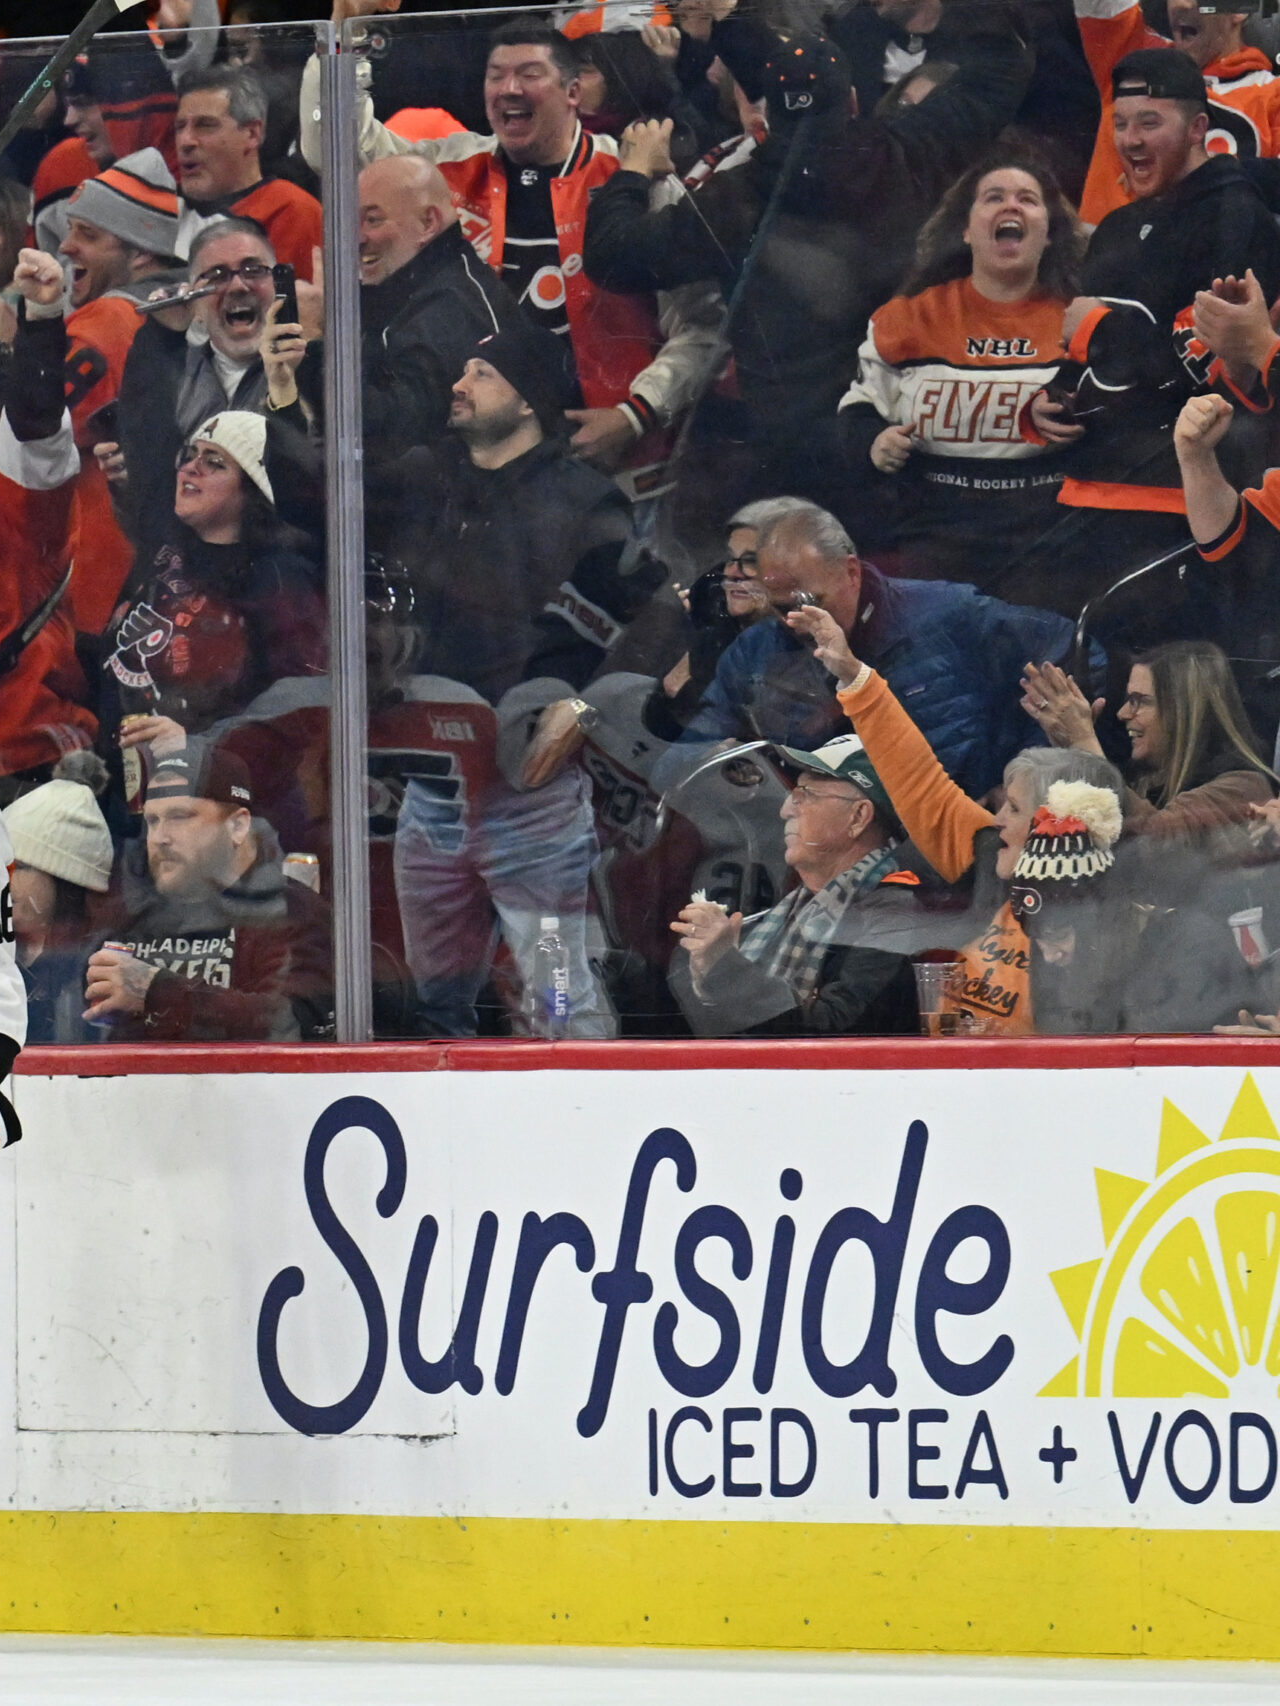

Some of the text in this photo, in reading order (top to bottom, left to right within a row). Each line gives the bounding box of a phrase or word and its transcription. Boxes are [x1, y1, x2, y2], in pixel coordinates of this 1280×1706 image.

[966, 337, 1037, 358] NHL
[973, 478, 1026, 490] HOCKEY
[552, 967, 567, 1016] smart
[258, 1095, 1015, 1438] Surfside
[649, 1406, 817, 1498] ICED
[850, 1408, 1009, 1500] TEA
[1107, 1409, 1278, 1505] VOD
